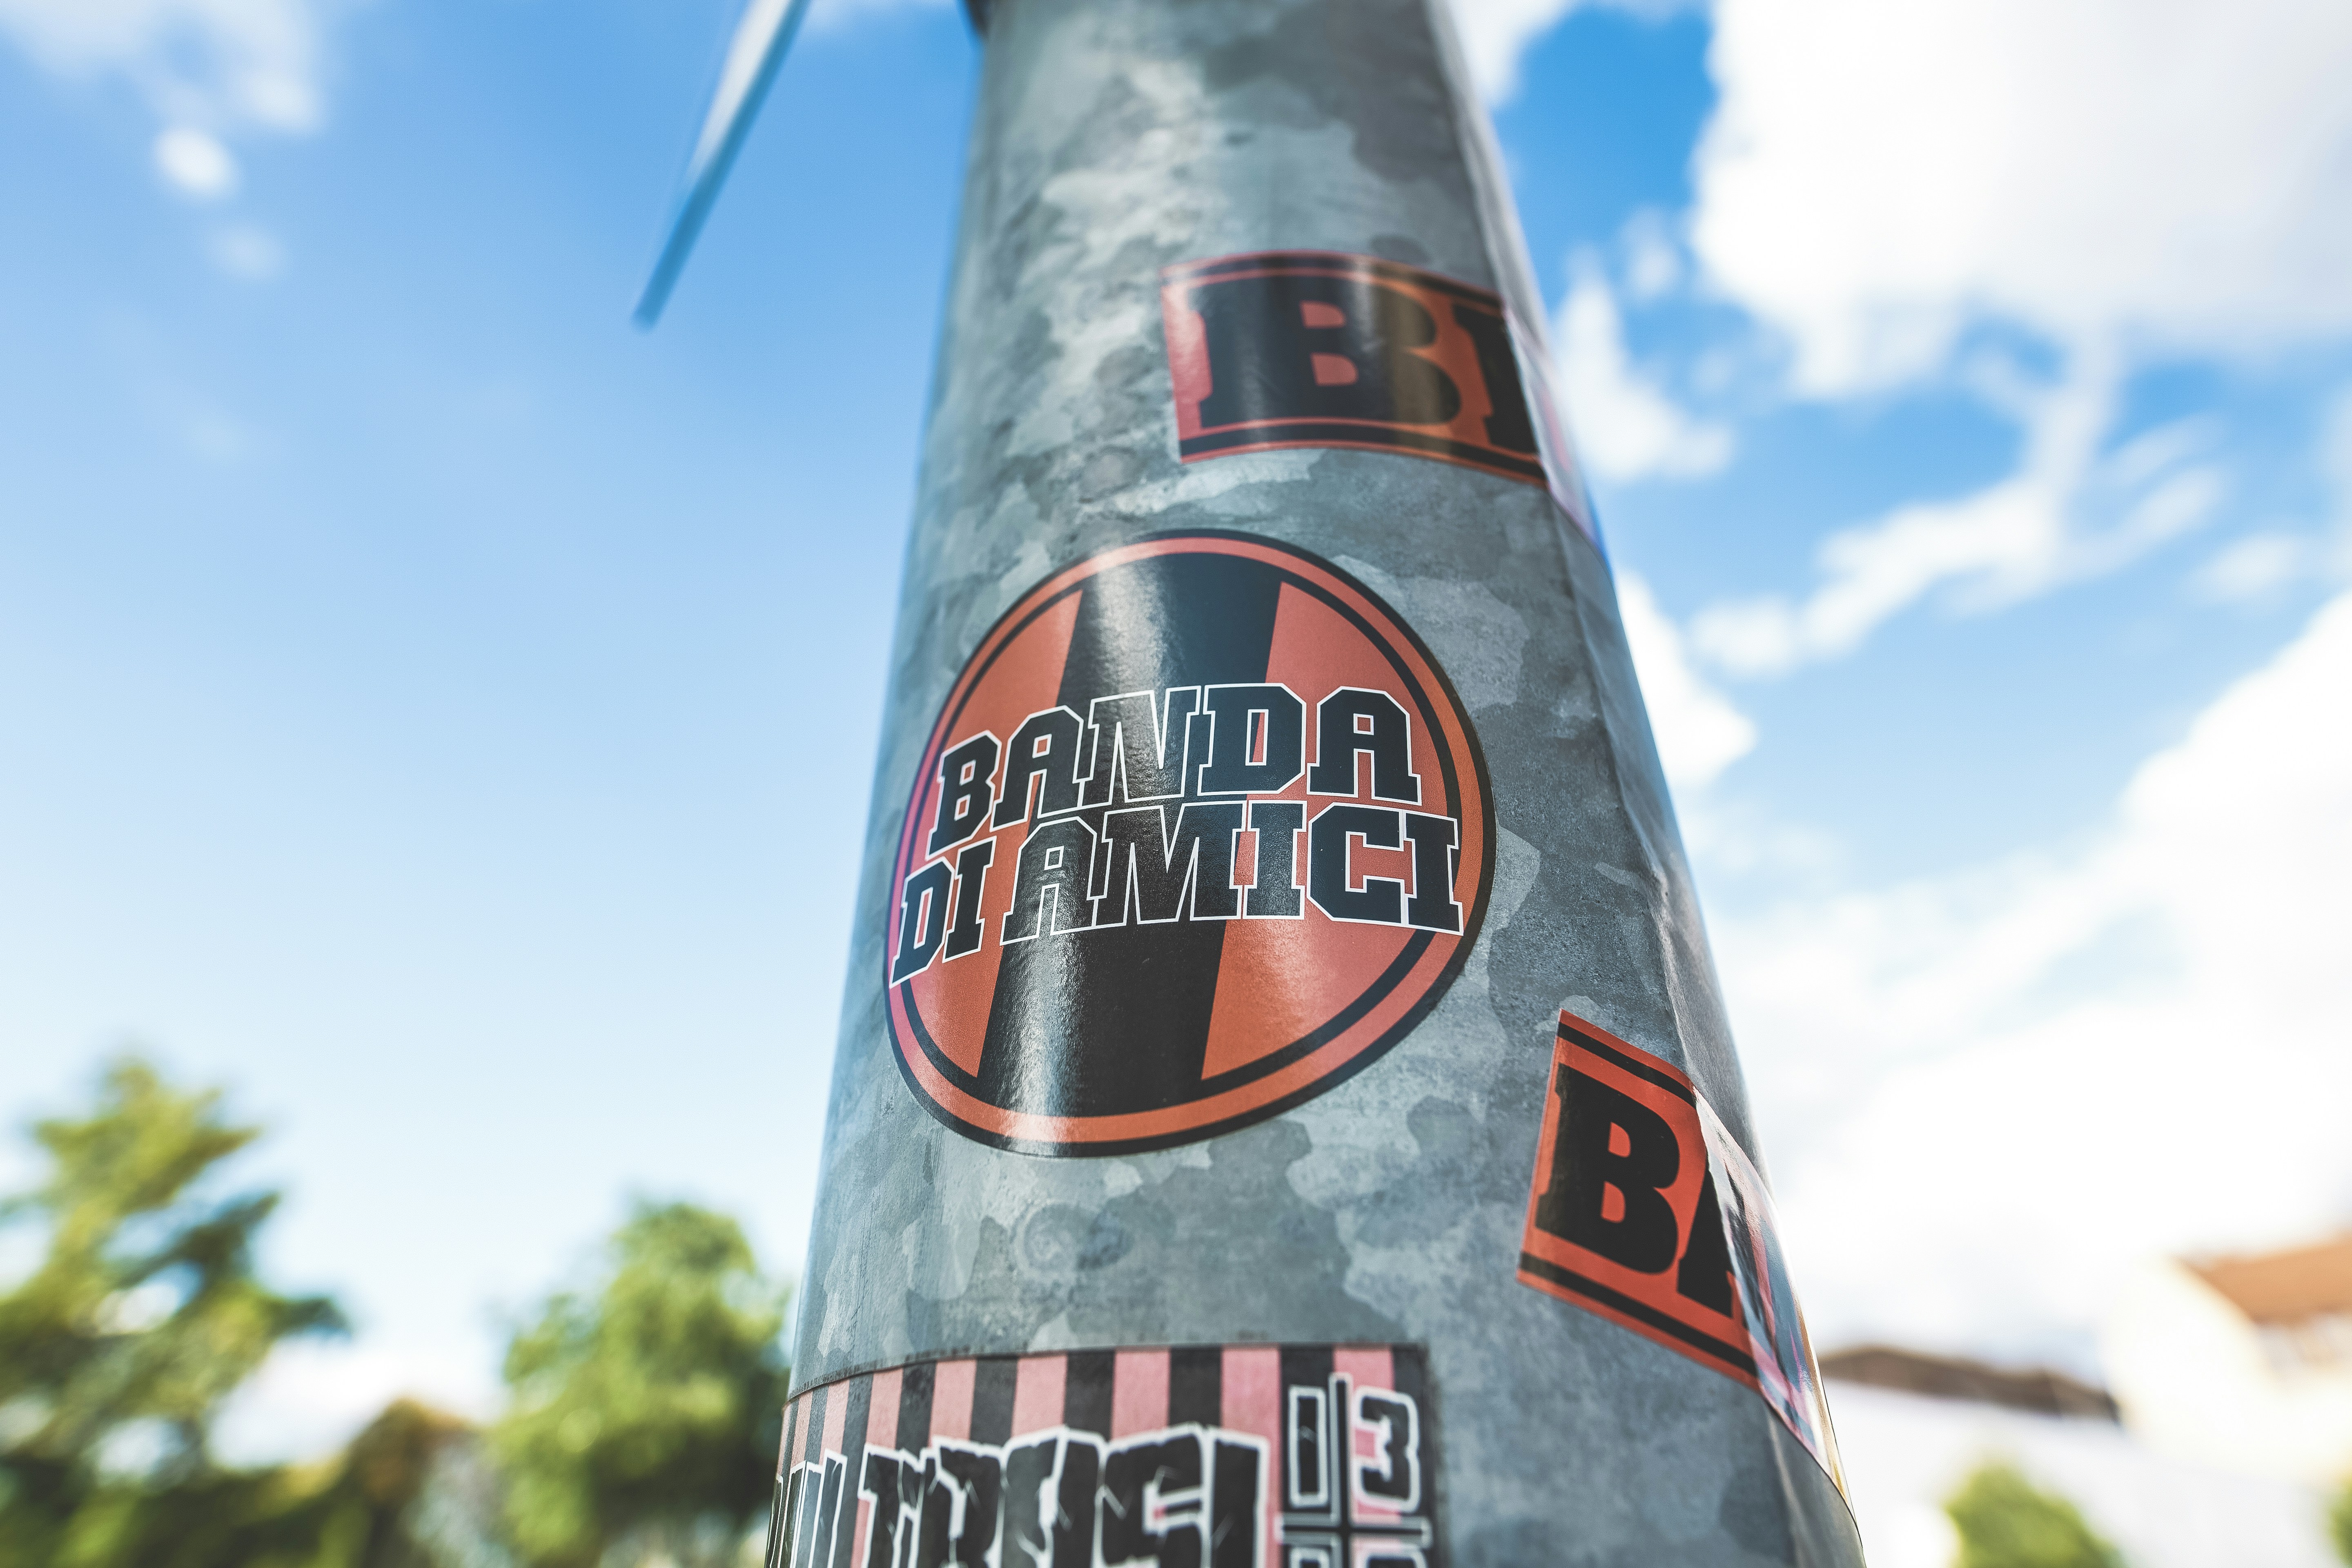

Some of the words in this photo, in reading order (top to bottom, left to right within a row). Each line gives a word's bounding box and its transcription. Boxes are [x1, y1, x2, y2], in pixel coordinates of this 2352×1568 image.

[925, 682, 1422, 860] BANDA
[889, 838, 996, 989] DI
[999, 799, 1465, 946] AMICI
